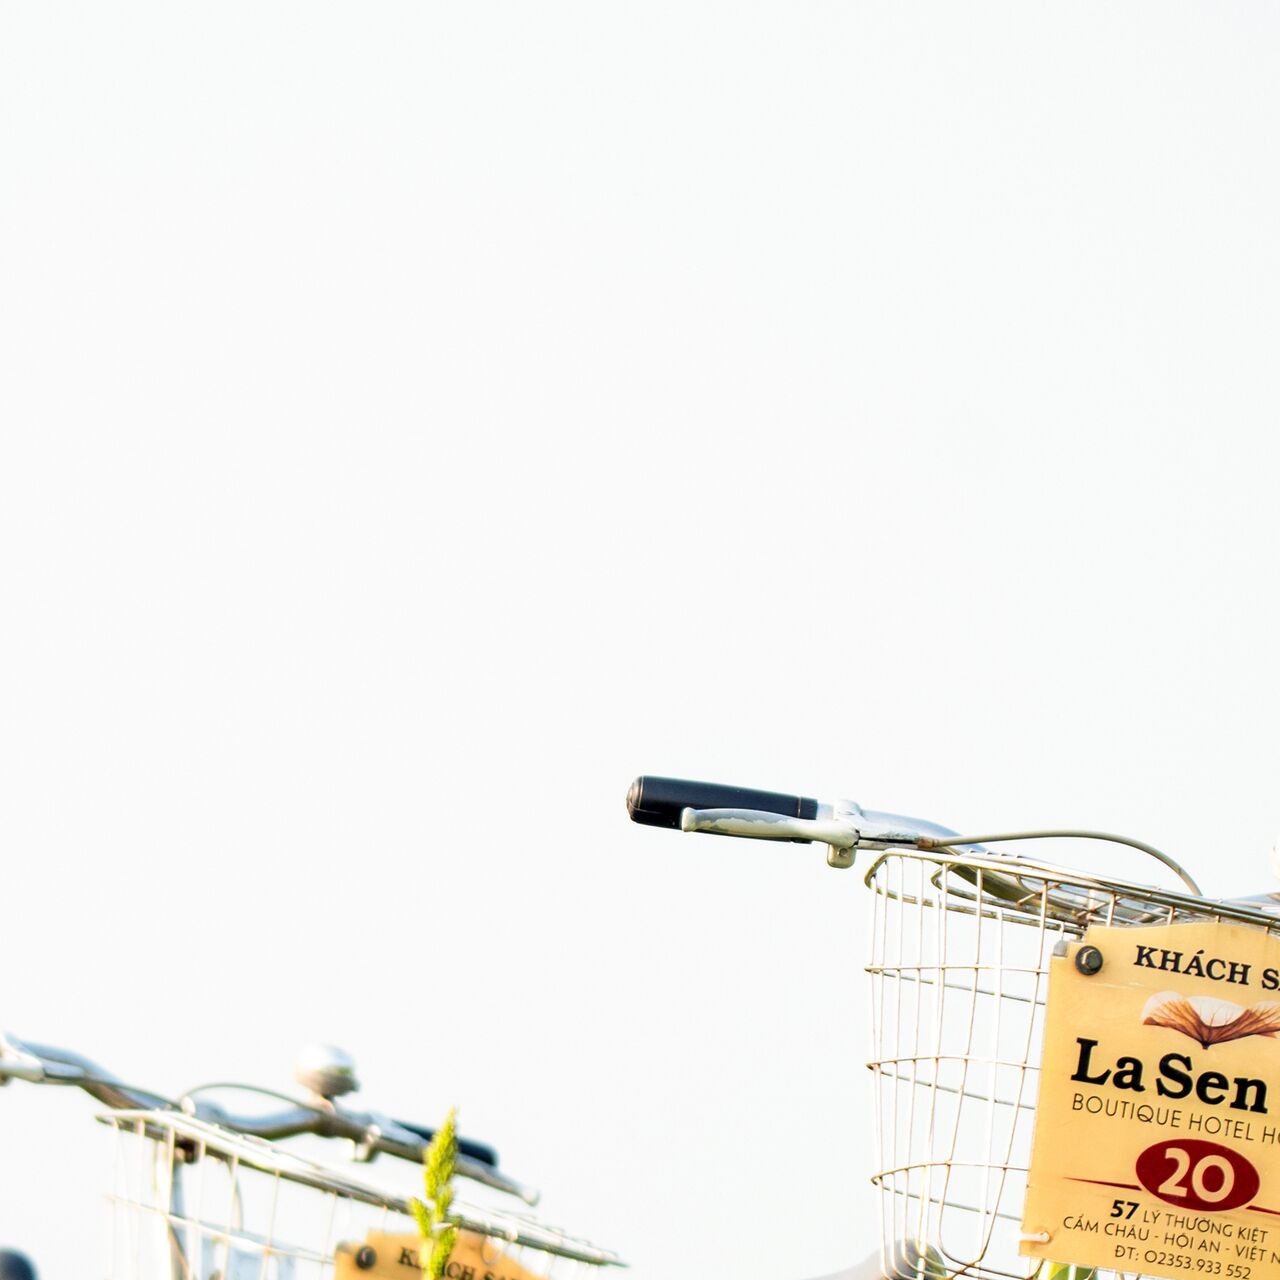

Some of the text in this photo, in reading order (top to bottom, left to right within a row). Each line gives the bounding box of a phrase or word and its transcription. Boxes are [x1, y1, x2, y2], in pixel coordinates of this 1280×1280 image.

[1133, 945, 1251, 986] KHÁCH
[1070, 1037, 1146, 1093] La
[1155, 1052, 1268, 1114] Sen
[1072, 1092, 1183, 1129] BOUTIQUE
[1188, 1114, 1255, 1141] HOTEL
[1157, 1147, 1235, 1203] 20
[1110, 1199, 1140, 1220] 57
[1143, 1209, 1161, 1224] LÝ
[1115, 1244, 1140, 1261] ĐT:
[1226, 1263, 1251, 1280] 552
[1198, 1239, 1221, 1253] AN
[1235, 1244, 1268, 1262] VIỆT
